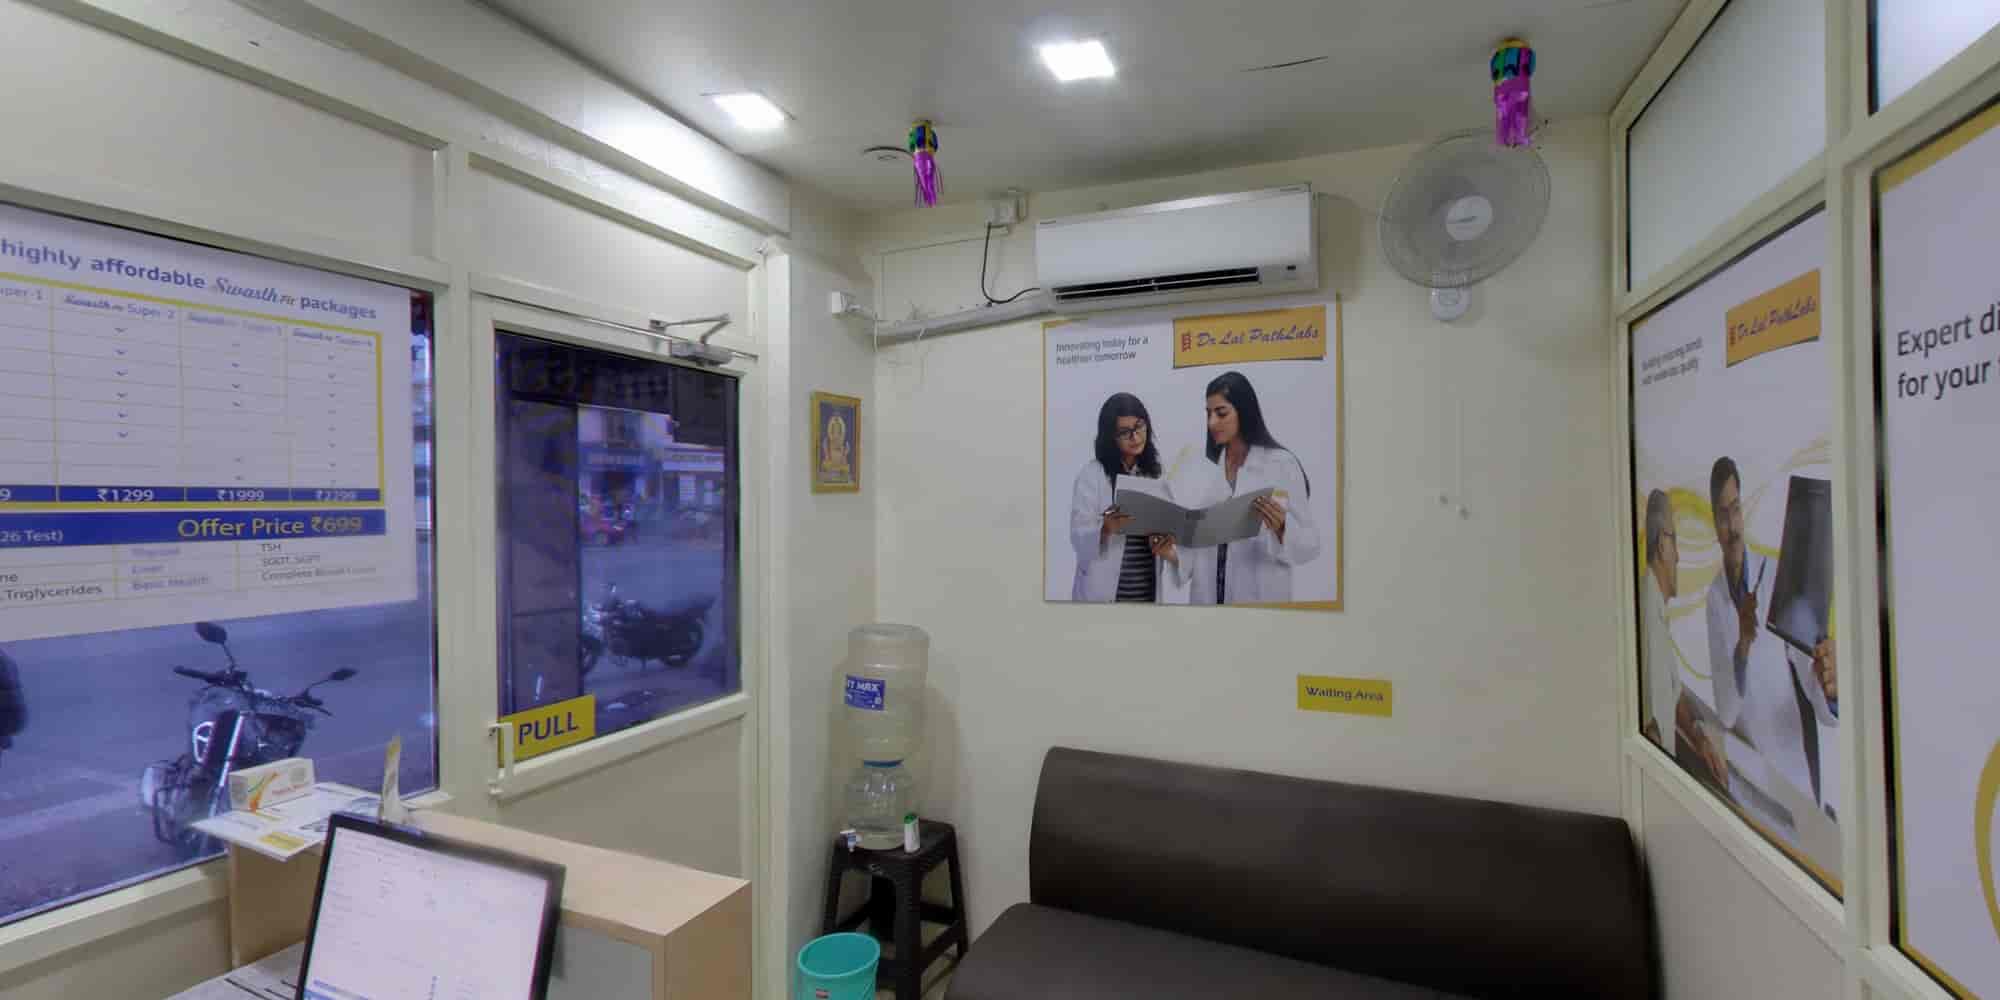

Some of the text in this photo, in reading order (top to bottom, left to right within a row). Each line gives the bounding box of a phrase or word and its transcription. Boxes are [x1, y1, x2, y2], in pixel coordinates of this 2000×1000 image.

[1, 237, 81, 271] highly
[91, 256, 206, 288] affordable
[212, 275, 278, 303] Swasth
[300, 295, 377, 320] packages
[1196, 323, 1320, 348] Dr Lal PathLabs
[1897, 313, 1973, 358] Expert
[1897, 370, 1929, 399] for
[1933, 360, 1991, 401] your
[97, 487, 155, 503] ₹1299
[216, 488, 265, 502] ₹1999
[24, 528, 64, 543] Test)
[178, 515, 363, 537] Offer Price ₹699
[7, 582, 103, 601] Triglycerides
[1305, 686, 1385, 704] Waiting Area
[518, 711, 580, 745] PULL
